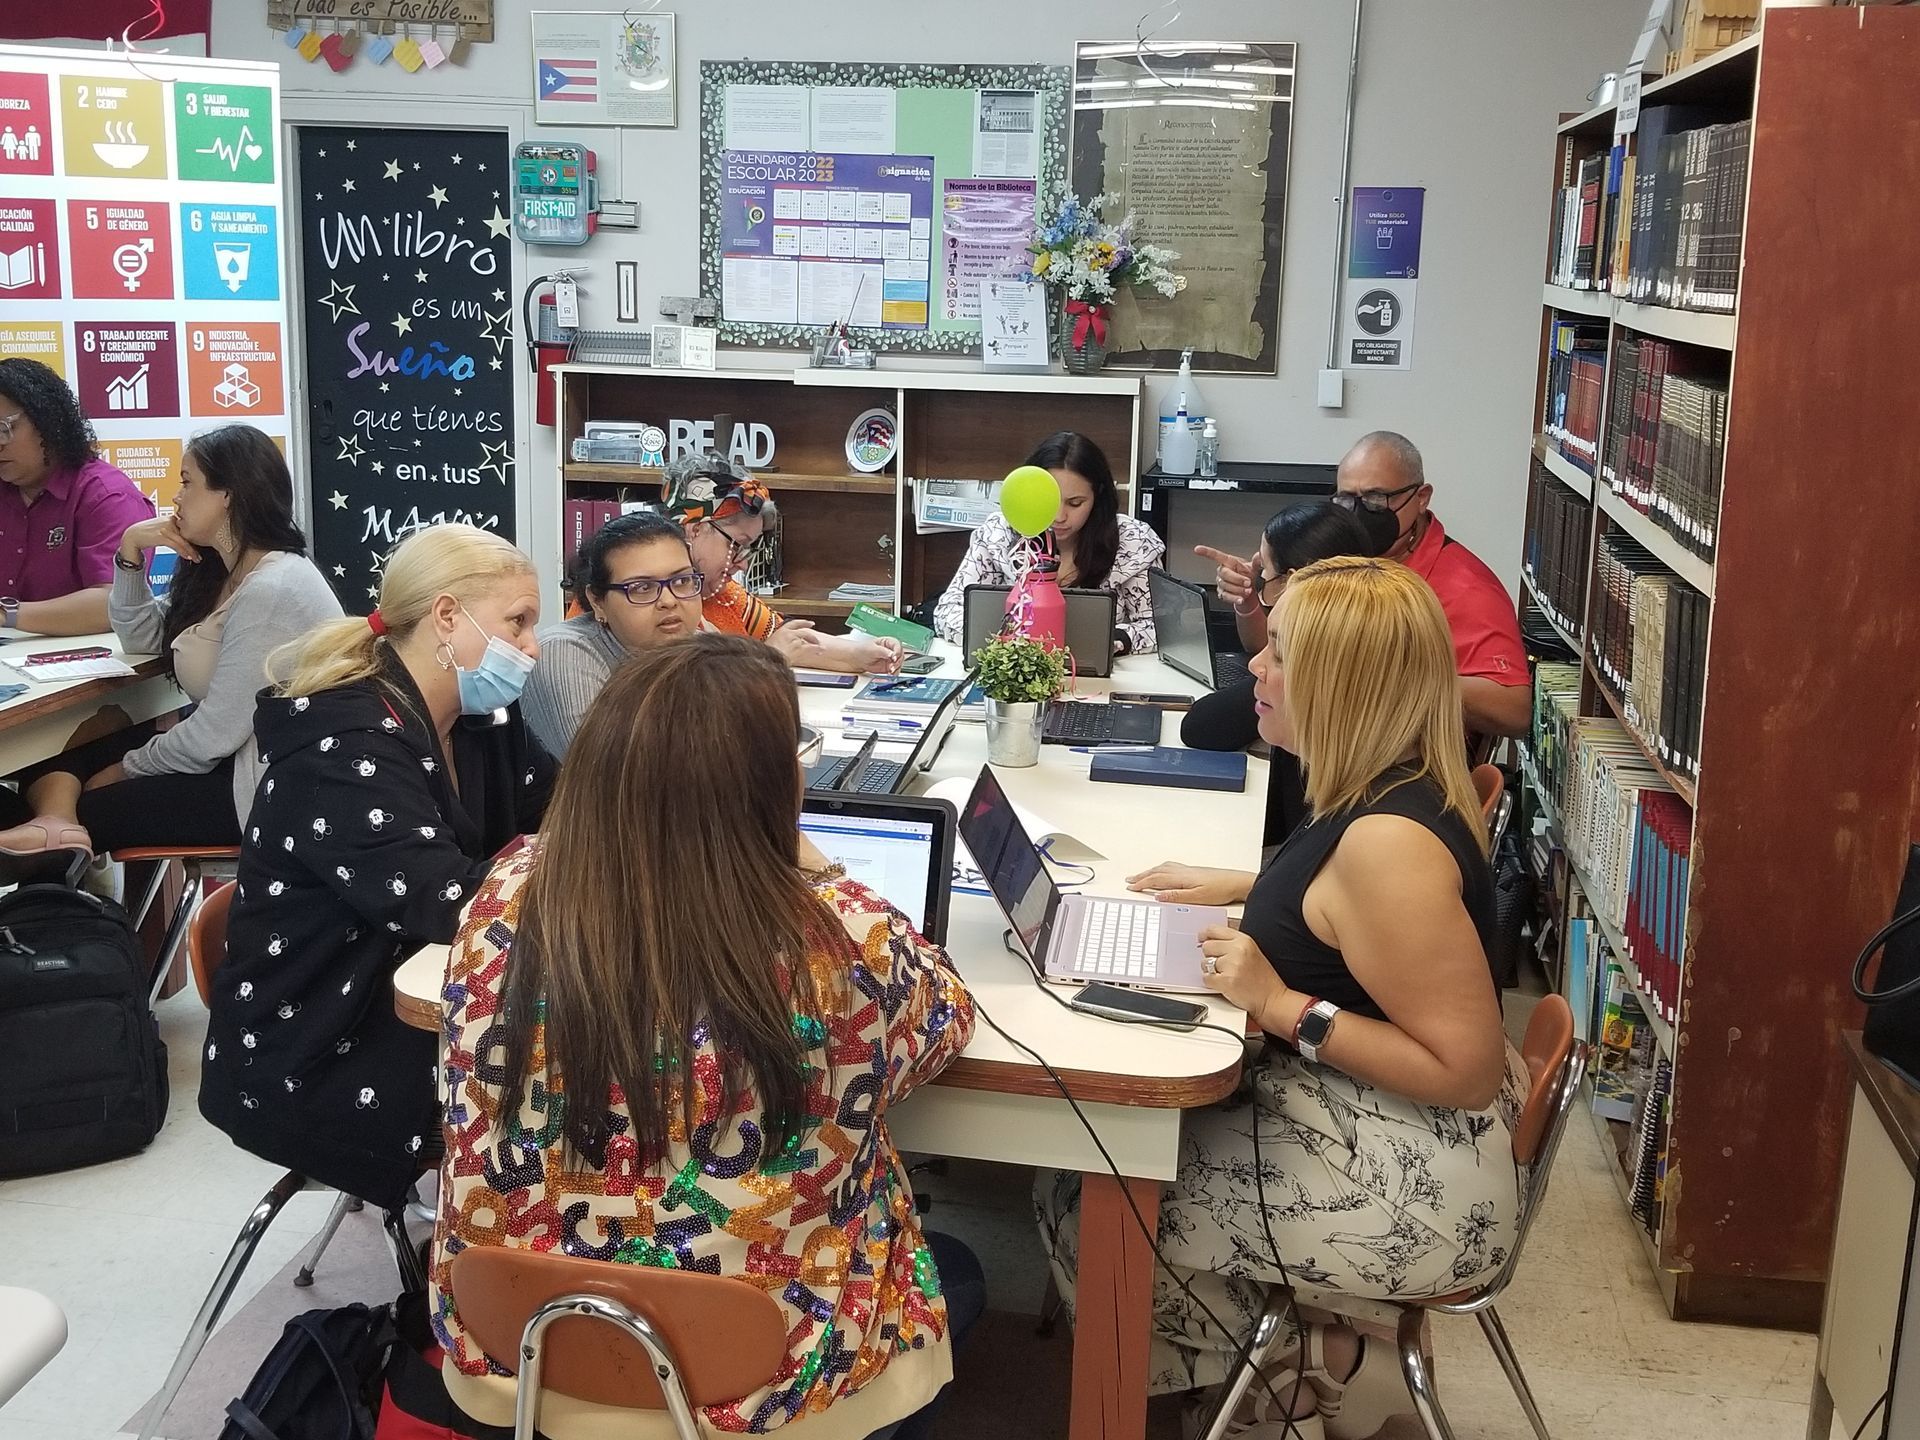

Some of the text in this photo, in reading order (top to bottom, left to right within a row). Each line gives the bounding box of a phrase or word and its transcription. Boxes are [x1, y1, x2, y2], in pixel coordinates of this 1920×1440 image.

[350, 1, 375, 17] es
[77, 85, 89, 109] 2
[95, 86, 128, 98] HAMBRE
[96, 98, 117, 110] CERO
[185, 92, 198, 115] 3
[203, 93, 228, 106] SALUD
[203, 106, 250, 118] Y BIENESTAR
[727, 153, 835, 169] CALENDARIO 2022
[727, 166, 834, 182] ESCOLAR 2023
[728, 187, 766, 195] EDUCACIÓN
[949, 182, 1031, 191] Normas de la Biblioteca
[106, 208, 145, 220] IGUALDAD
[524, 200, 576, 217] FIRST AID
[86, 207, 98, 230] 5
[190, 210, 203, 233] 6
[211, 211, 258, 223] AGUA LIMPIA
[1, 221, 35, 232] CALIDAD
[107, 217, 149, 231] DE GÉNERO
[211, 222, 268, 234] Y SANEAMIENTO
[394, 210, 497, 275] libro
[412, 297, 482, 321] es un
[16, 331, 56, 342] ASEQUIBLE
[83, 330, 96, 352] 8
[99, 330, 169, 341] TRABAJO DECENTE
[193, 330, 205, 352] 9
[1, 343, 58, 353] CONTAMINANTE
[99, 341, 156, 352] Y CRECIMIENTO
[209, 340, 260, 351] INNOVACIÓN E
[347, 321, 476, 381] Sueño
[100, 351, 145, 363] ECONÓMICO
[209, 351, 277, 363] INFRAESTRUCTURA
[353, 408, 402, 440] que
[669, 418, 776, 469] READ
[116, 447, 161, 458] CIUDADES Y
[116, 457, 170, 469] COMUNIDADES
[123, 468, 167, 479] OSTENIBLES
[396, 462, 481, 485] en tus
[953, 511, 968, 522] 100
[360, 505, 499, 544] MAN
